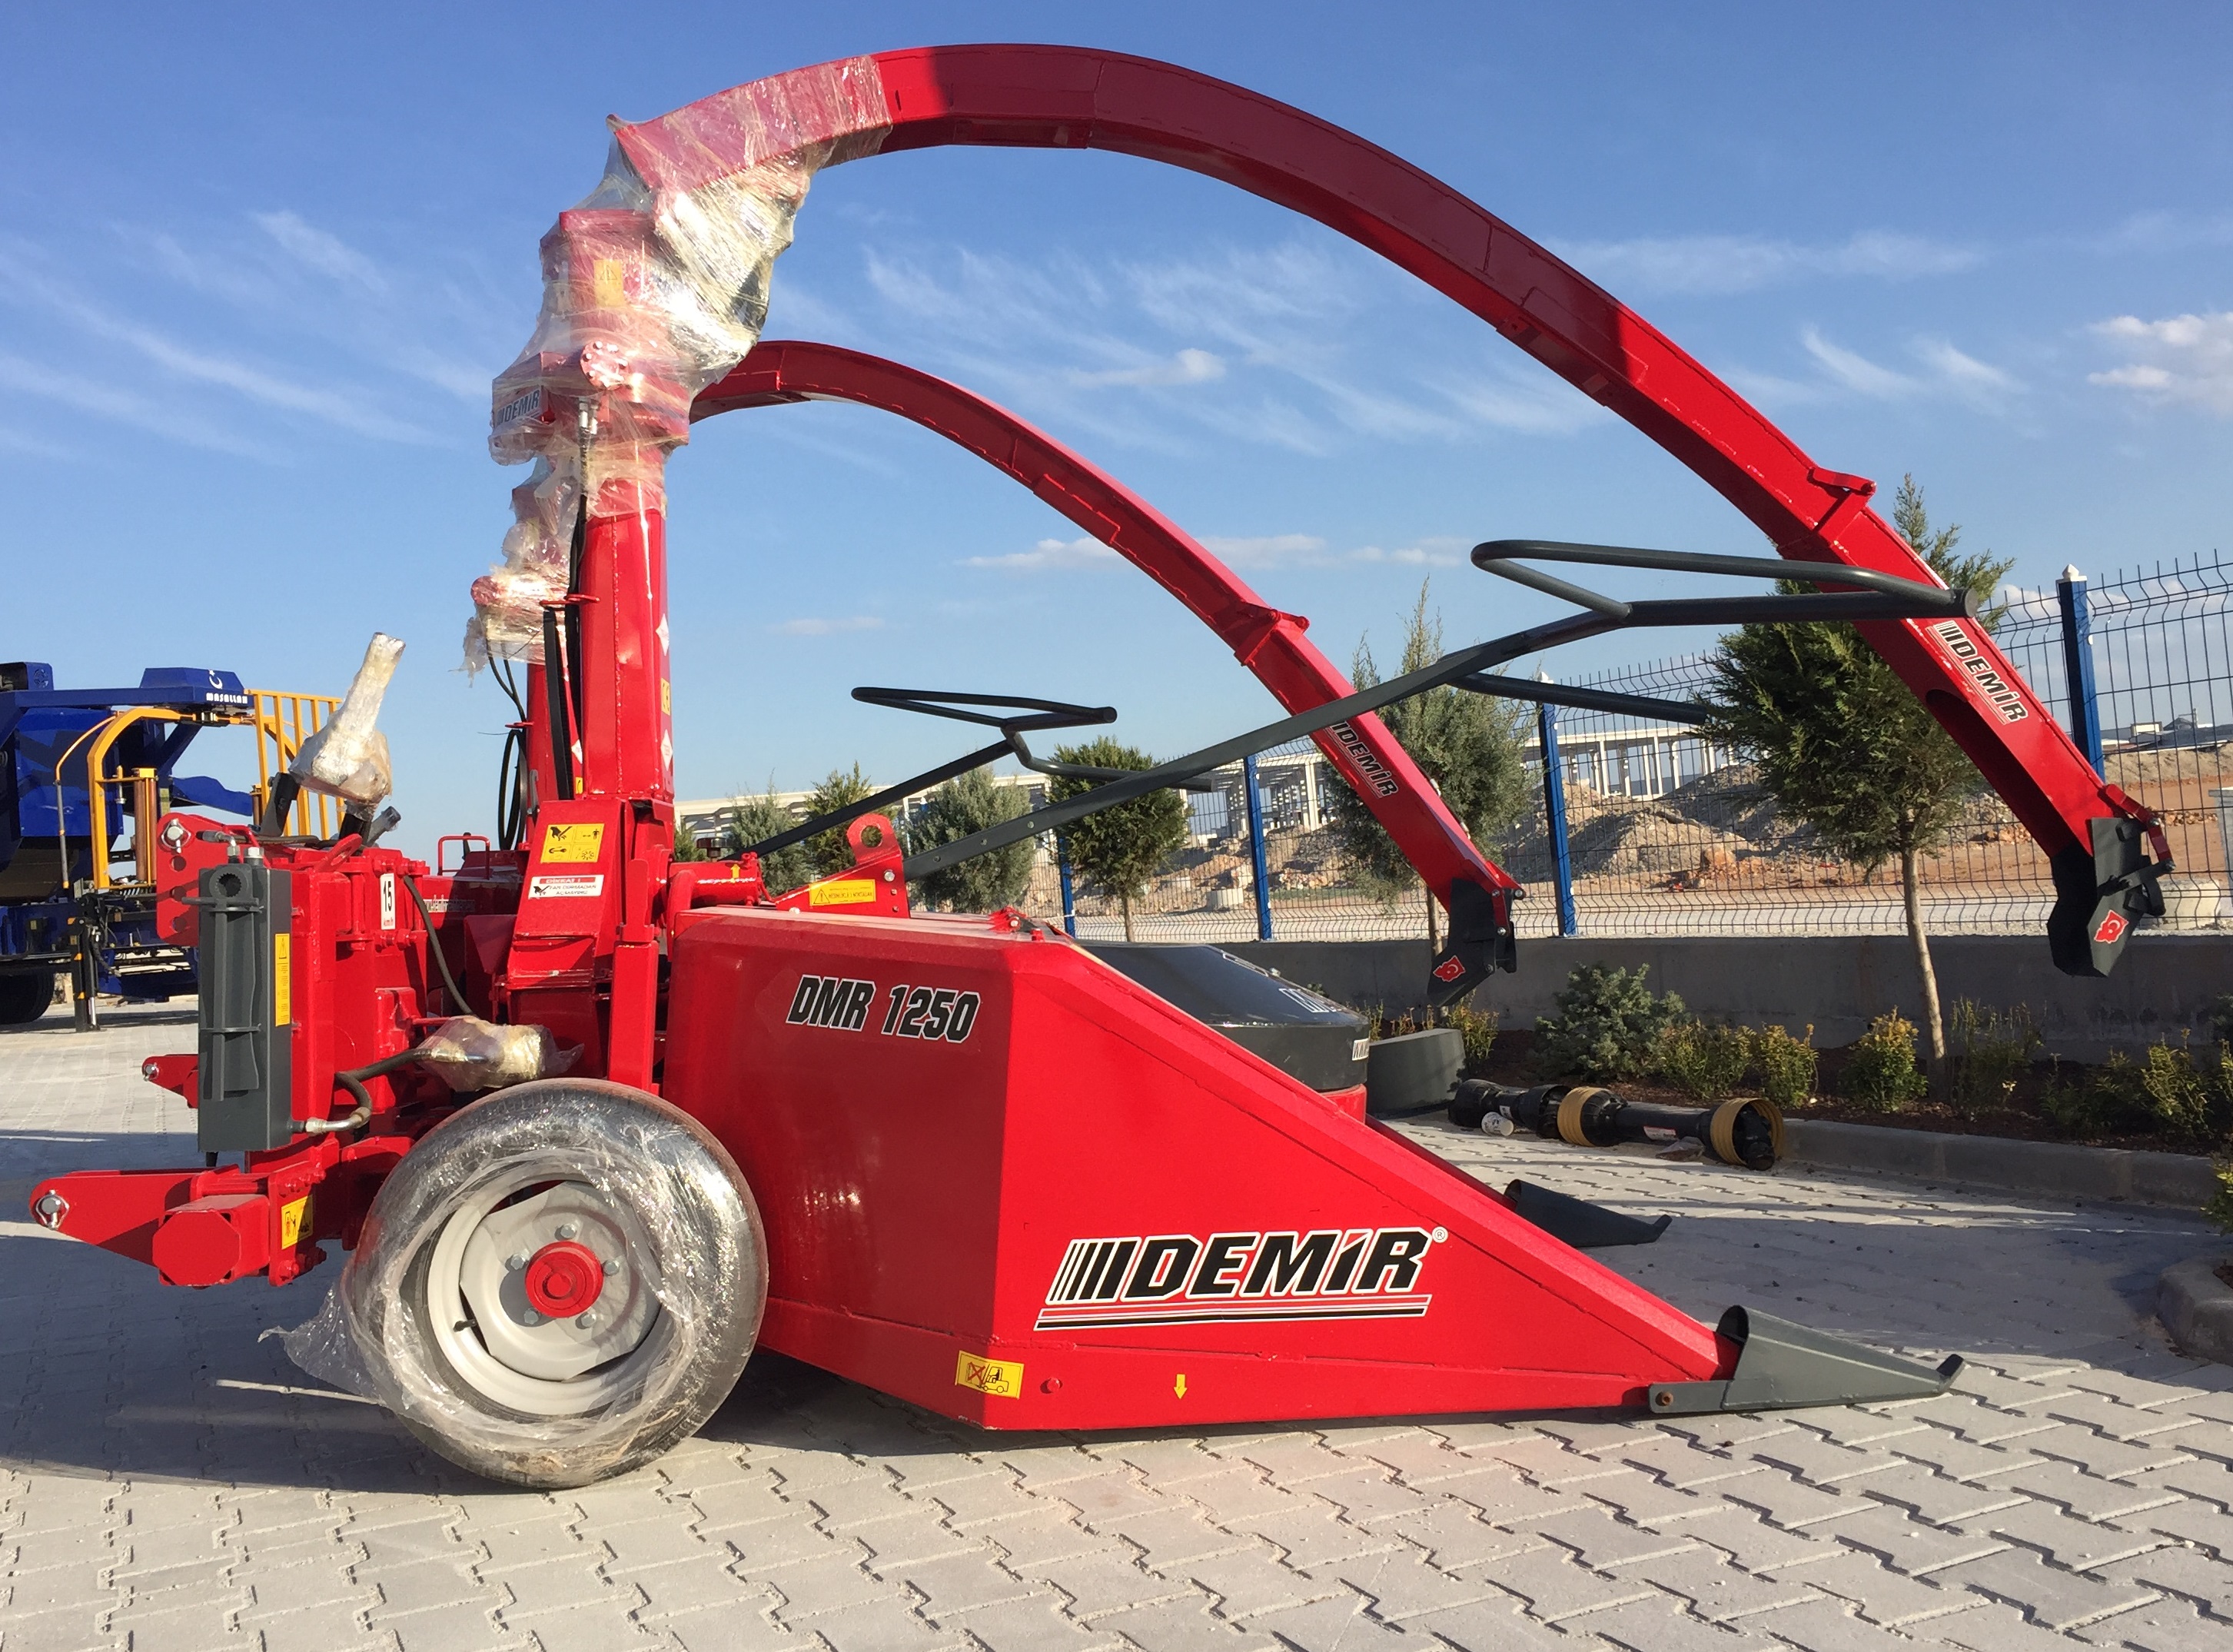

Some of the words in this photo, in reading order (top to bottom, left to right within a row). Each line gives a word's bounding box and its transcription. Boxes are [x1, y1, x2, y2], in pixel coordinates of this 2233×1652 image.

[384, 880, 392, 912] 15
[786, 974, 876, 1032] DMR
[881, 984, 980, 1044] 1250
